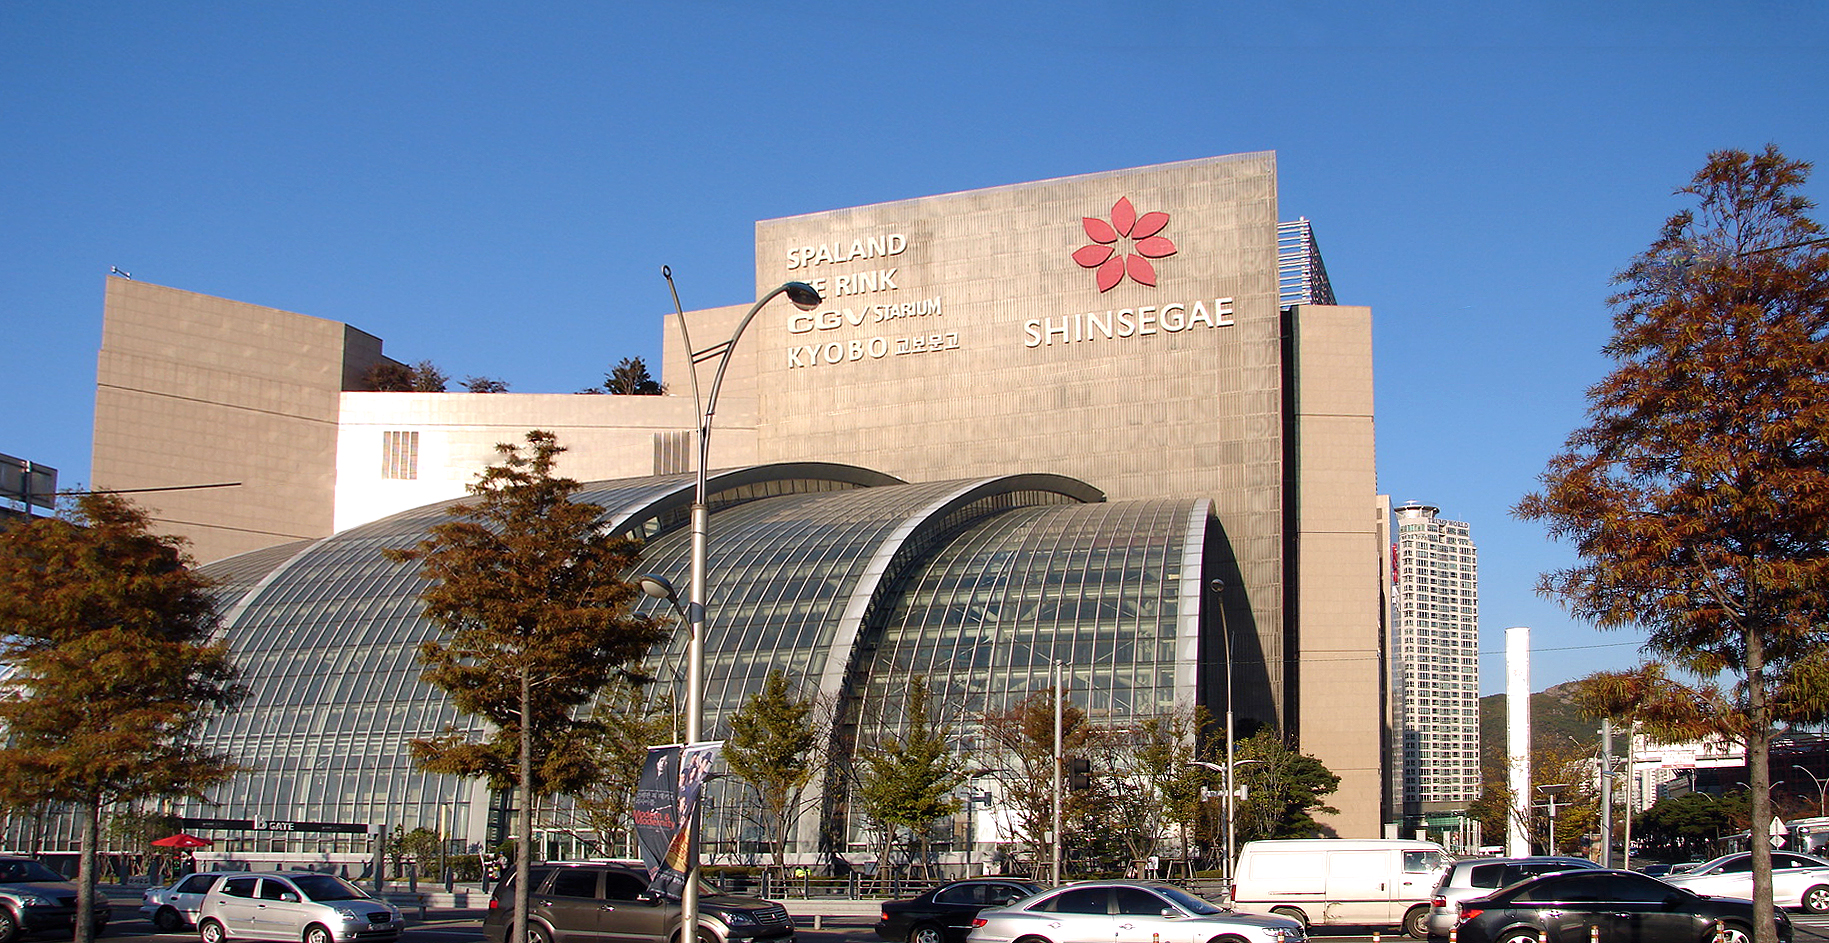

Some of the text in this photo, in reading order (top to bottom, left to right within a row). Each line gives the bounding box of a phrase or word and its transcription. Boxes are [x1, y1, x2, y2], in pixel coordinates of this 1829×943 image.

[786, 233, 908, 270] SPALAND
[835, 268, 898, 298] RINK
[787, 296, 942, 334] CGV STARIUM
[1024, 297, 1235, 348] SHINSEGAE
[787, 332, 960, 369] KYOBO 교보문고
[1448, 520, 1469, 528] WORLD
[269, 822, 295, 831] GATE
